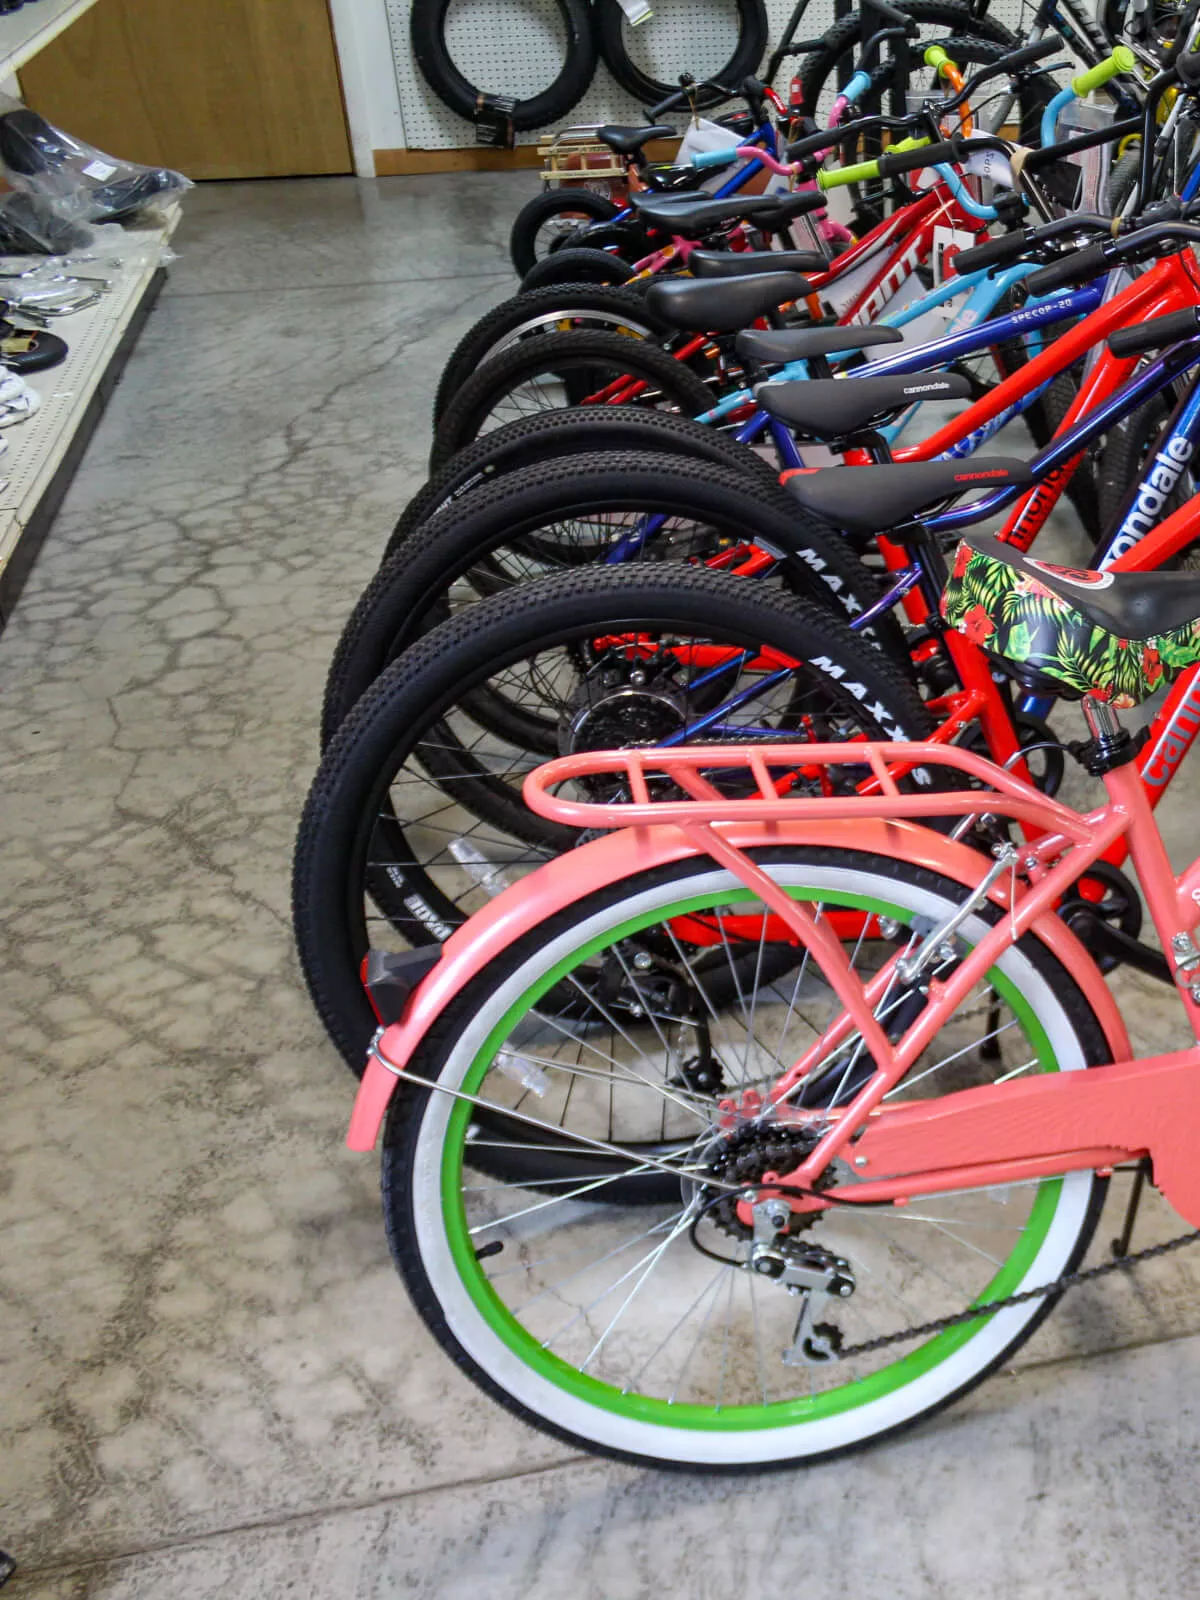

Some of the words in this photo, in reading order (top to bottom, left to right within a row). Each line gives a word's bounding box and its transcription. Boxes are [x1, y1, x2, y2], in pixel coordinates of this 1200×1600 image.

[903, 381, 950, 395] cannondale
[954, 468, 1009, 482] cannondale
[1099, 436, 1193, 571] ondale
[807, 655, 932, 786] MAXXS
